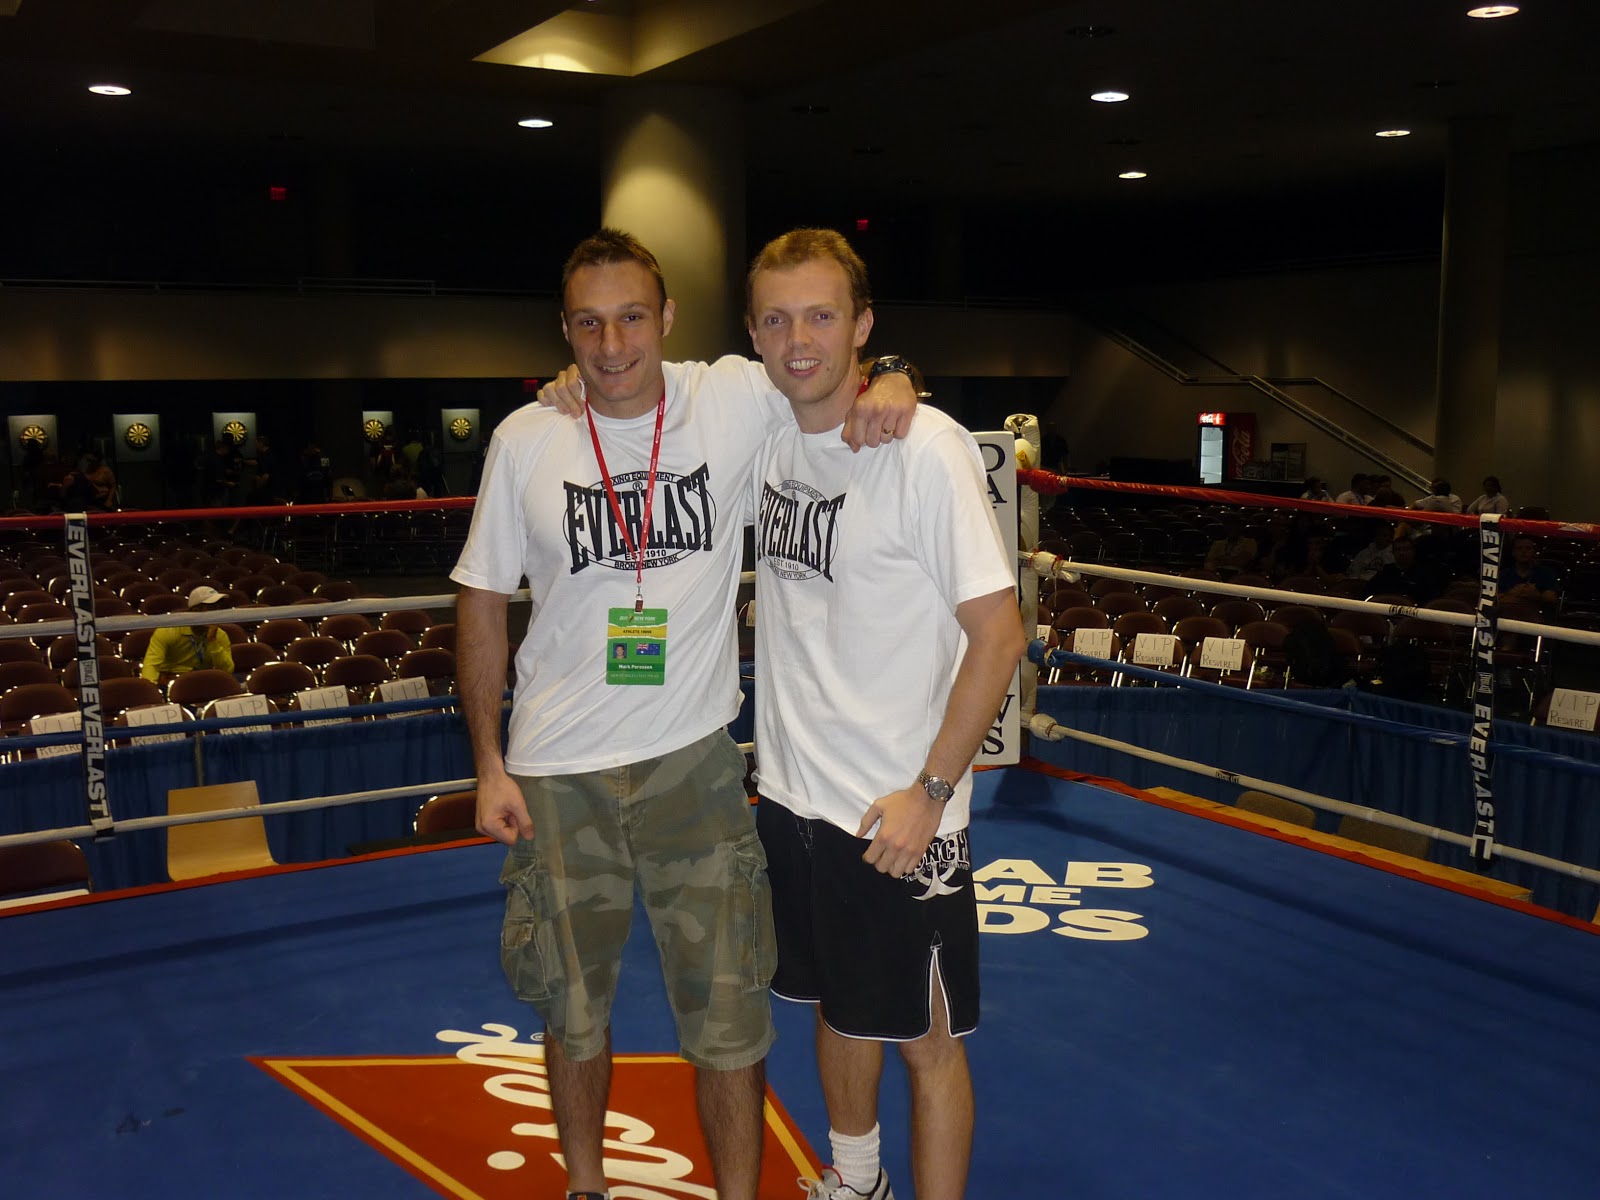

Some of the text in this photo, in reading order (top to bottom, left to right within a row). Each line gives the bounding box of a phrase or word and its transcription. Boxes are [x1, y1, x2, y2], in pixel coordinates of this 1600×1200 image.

[601, 472, 676, 489] BXING EQUIMENT
[563, 462, 713, 575] EVERLAST
[643, 559, 658, 570] NEW
[659, 554, 680, 567] YORK
[646, 550, 667, 558] 1910
[785, 561, 799, 571] 1910
[1477, 530, 1500, 665] EVERLAST
[68, 525, 95, 658] EVERLAST
[82, 687, 110, 818] EVERLAST
[1470, 703, 1495, 834] EVERLAST
[972, 858, 1155, 889] AB
[974, 882, 1082, 905] ME
[975, 903, 1149, 941] DS
